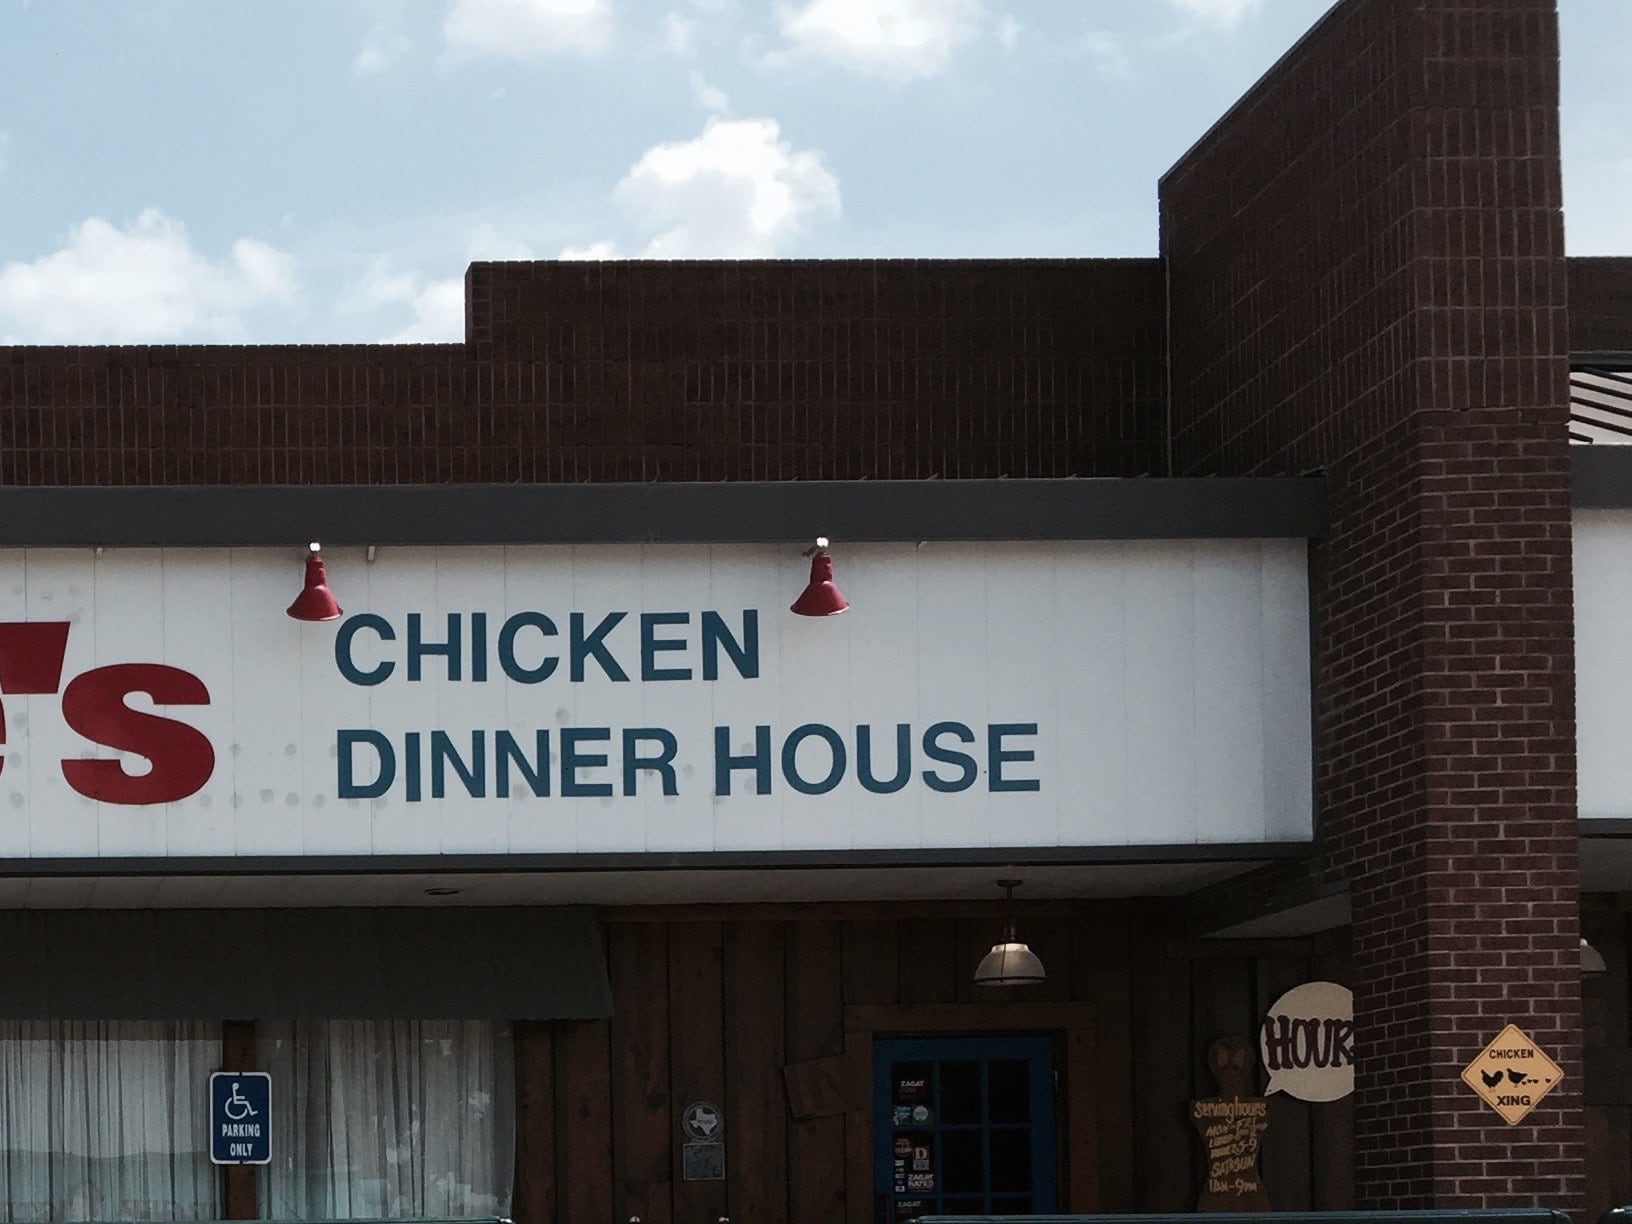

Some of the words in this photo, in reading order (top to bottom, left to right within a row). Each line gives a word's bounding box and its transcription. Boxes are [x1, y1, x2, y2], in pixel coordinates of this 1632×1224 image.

[334, 609, 760, 686] CHICKEN
[336, 727, 679, 802] DINNER
[714, 721, 1041, 798] HOUSE
[1489, 1049, 1534, 1059] CHICKEN
[1496, 1095, 1531, 1106] XING
[222, 1124, 260, 1137] PARKING
[230, 1143, 253, 1156] ONLY
